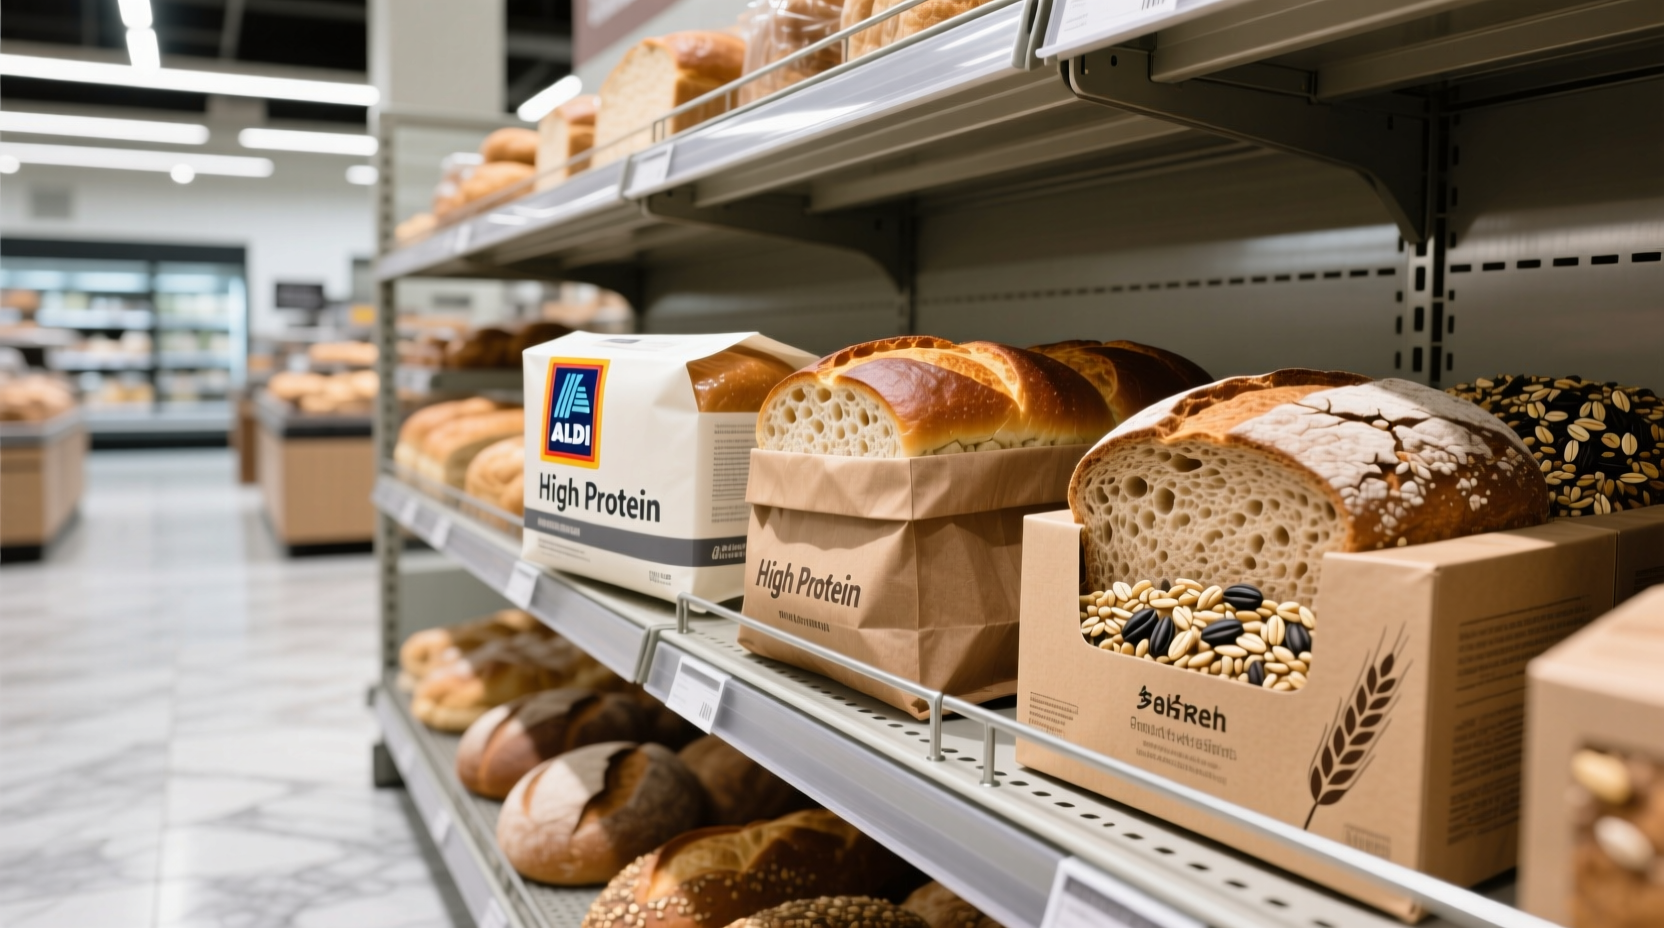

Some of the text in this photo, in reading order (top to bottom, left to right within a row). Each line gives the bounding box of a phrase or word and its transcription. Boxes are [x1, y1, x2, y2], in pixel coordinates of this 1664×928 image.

[551, 422, 590, 446] ALDI
[539, 472, 661, 522] High Protein
[755, 558, 861, 608] High Protein
